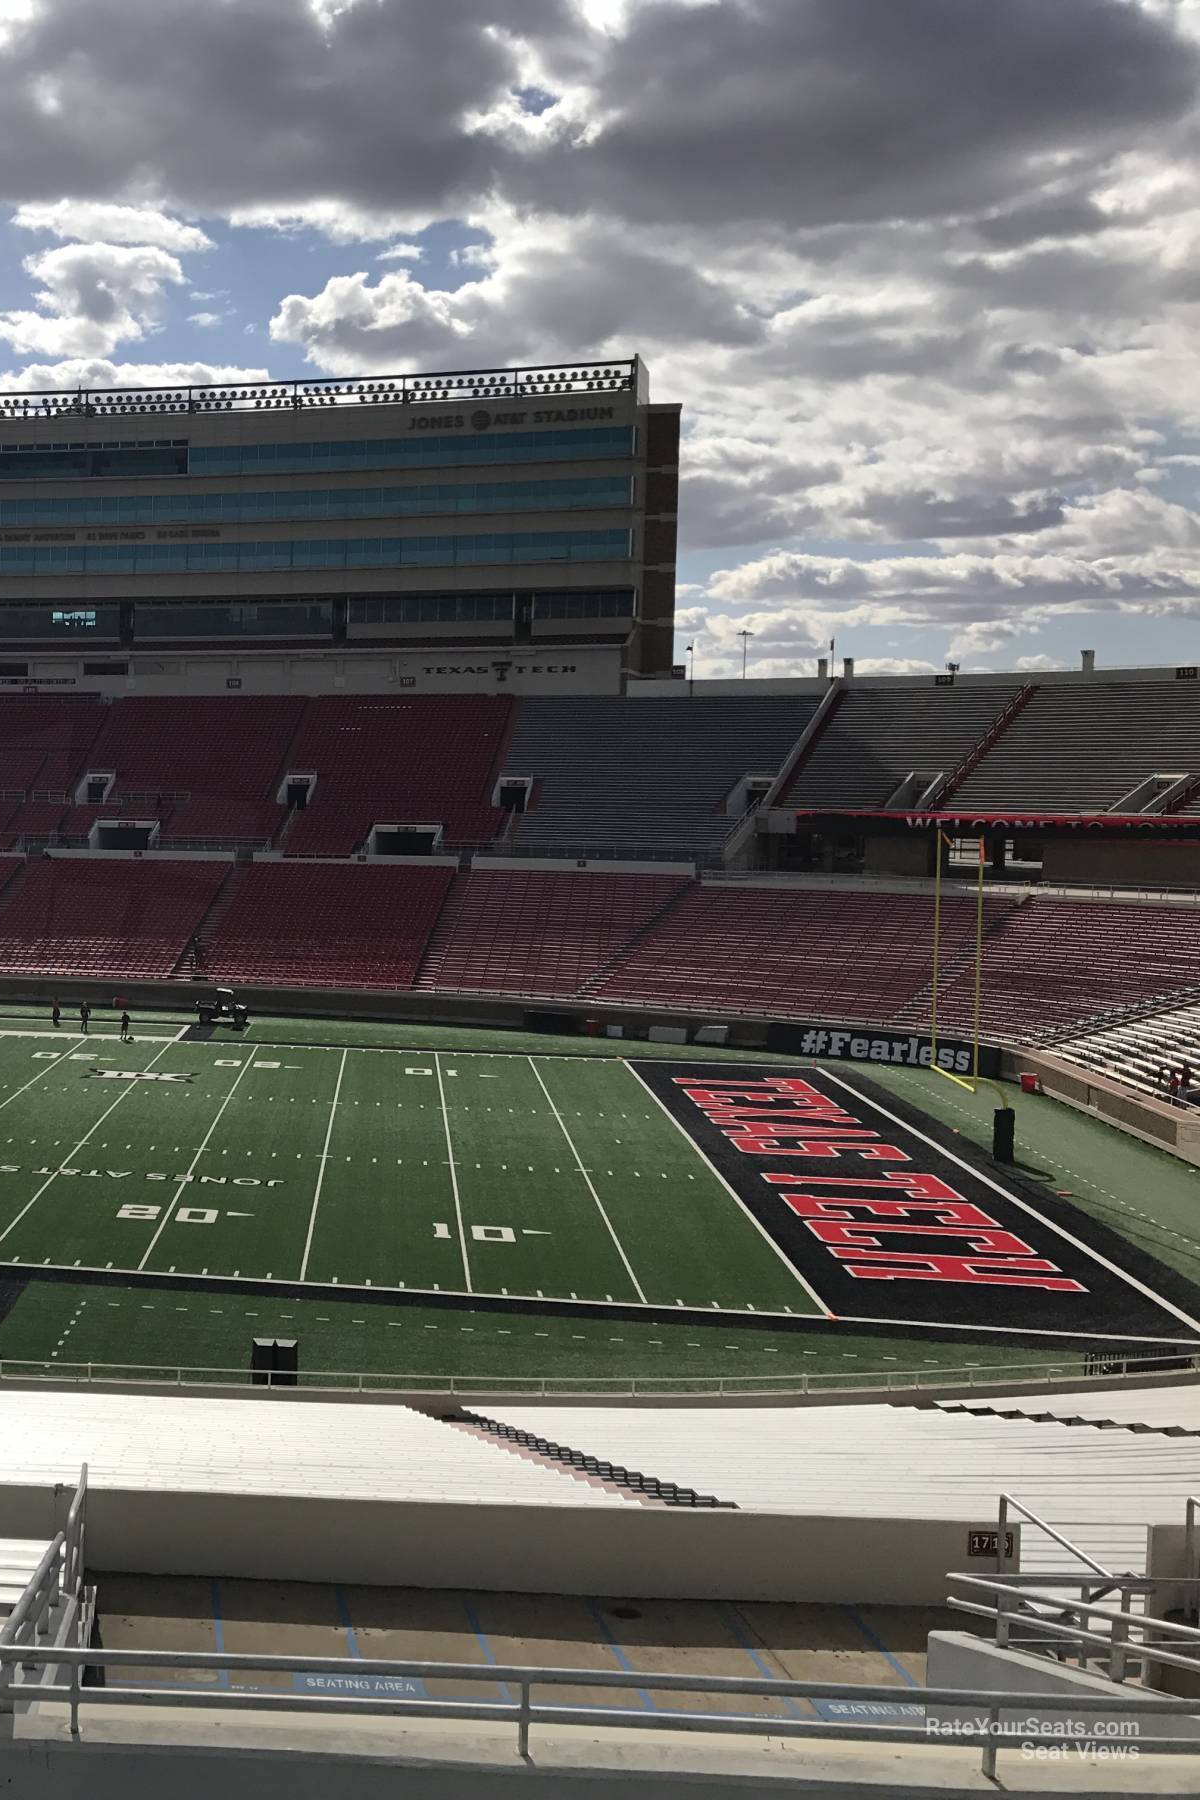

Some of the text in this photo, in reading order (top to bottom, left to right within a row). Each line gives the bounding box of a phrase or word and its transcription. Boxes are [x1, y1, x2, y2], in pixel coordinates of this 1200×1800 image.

[408, 407, 614, 430] JONES AT&T STADIUM
[423, 666, 488, 674] TEXAS
[515, 665, 577, 674] TECH
[32, 1051, 99, 1061] 30
[800, 1029, 971, 1072] #Fearless
[214, 1059, 281, 1069] 20
[405, 1068, 458, 1076] 10
[32, 1165, 134, 1180] AT&T
[146, 1172, 287, 1188] JONES
[671, 1077, 1090, 1293] TEXAS TECH
[116, 1203, 219, 1224] 20
[433, 1223, 516, 1242] 10
[972, 1536, 989, 1549] 17
[306, 1678, 416, 1692] SEATING AREA
[829, 1704, 898, 1716] SEATING
